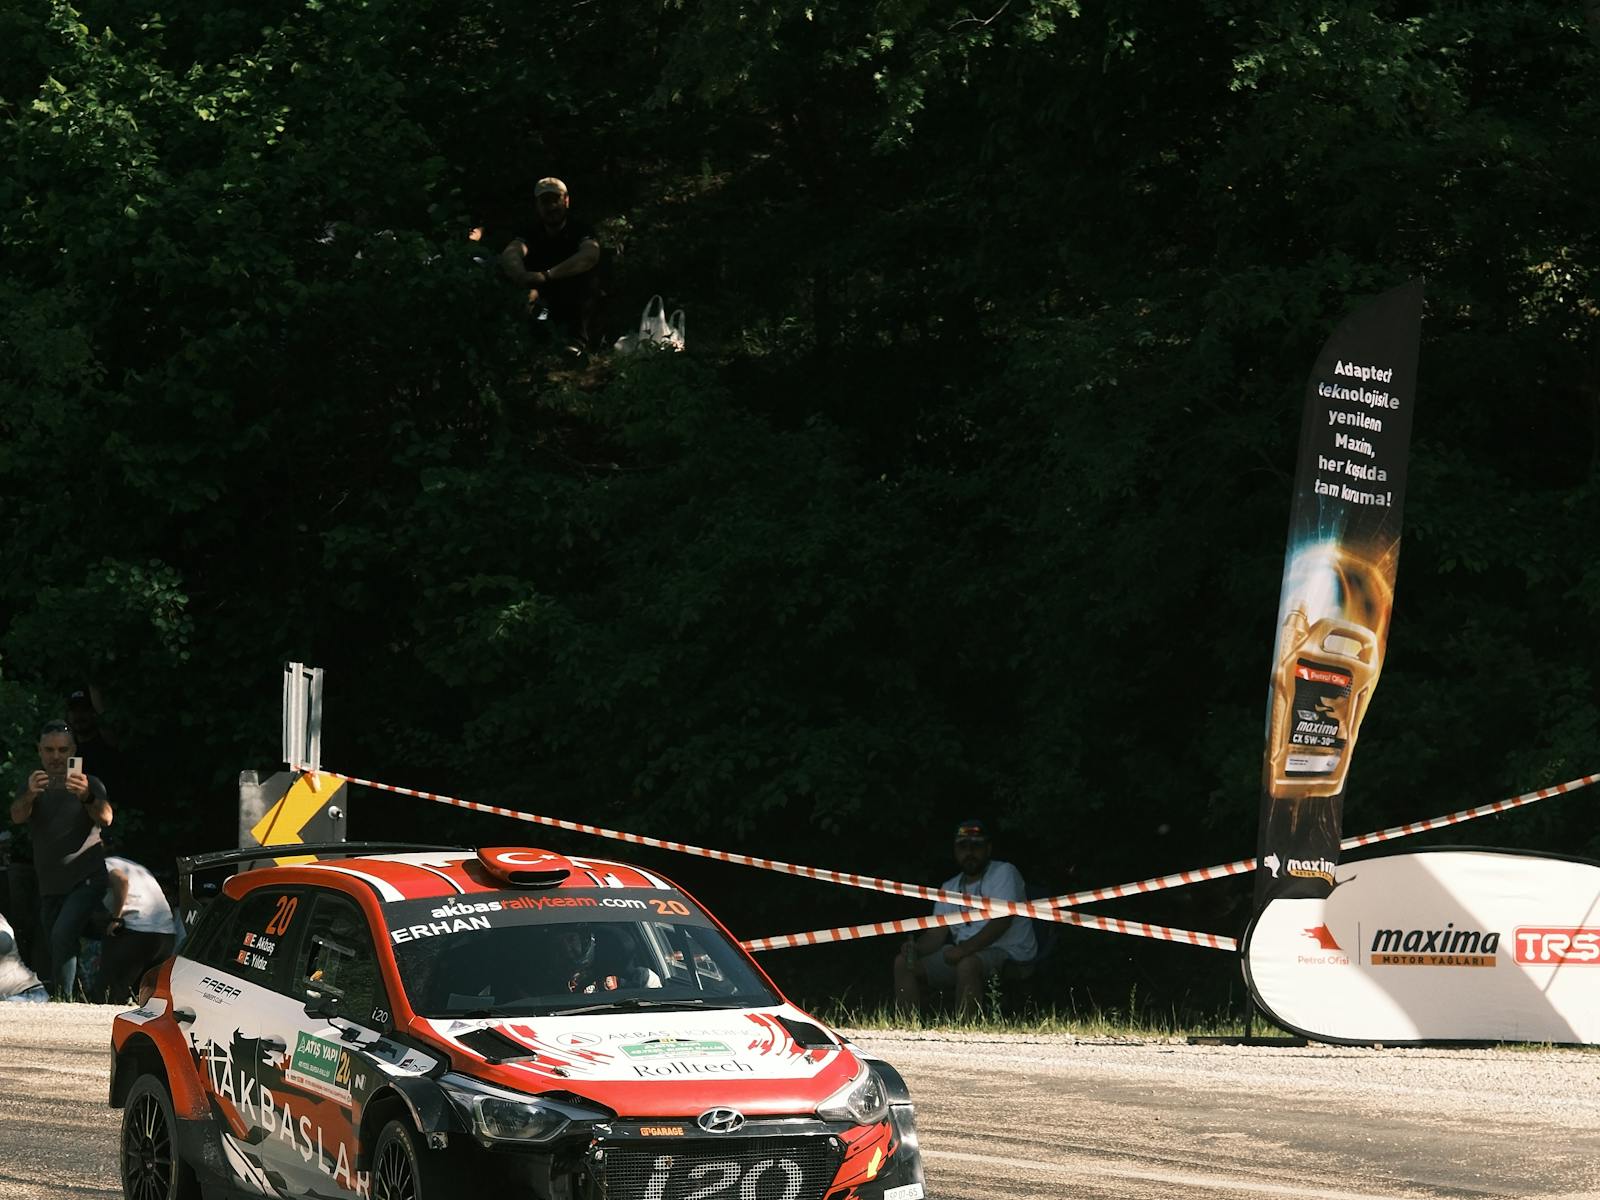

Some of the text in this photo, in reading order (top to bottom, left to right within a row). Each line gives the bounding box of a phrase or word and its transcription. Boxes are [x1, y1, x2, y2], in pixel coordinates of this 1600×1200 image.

[1318, 455, 1344, 473] her
[1314, 479, 1339, 498] tam
[1292, 734, 1303, 743] CX
[265, 895, 298, 937] 20
[431, 896, 691, 919] akbasrallyteam.com 20
[390, 916, 491, 945] ERHAN
[1371, 923, 1501, 954] maxima
[1298, 955, 1326, 965] Petrol
[1382, 954, 1485, 966] MOTOR YAĞLARI
[371, 1006, 389, 1024] i20
[322, 1044, 339, 1063] YAPI
[632, 1060, 755, 1078] Rolltech
